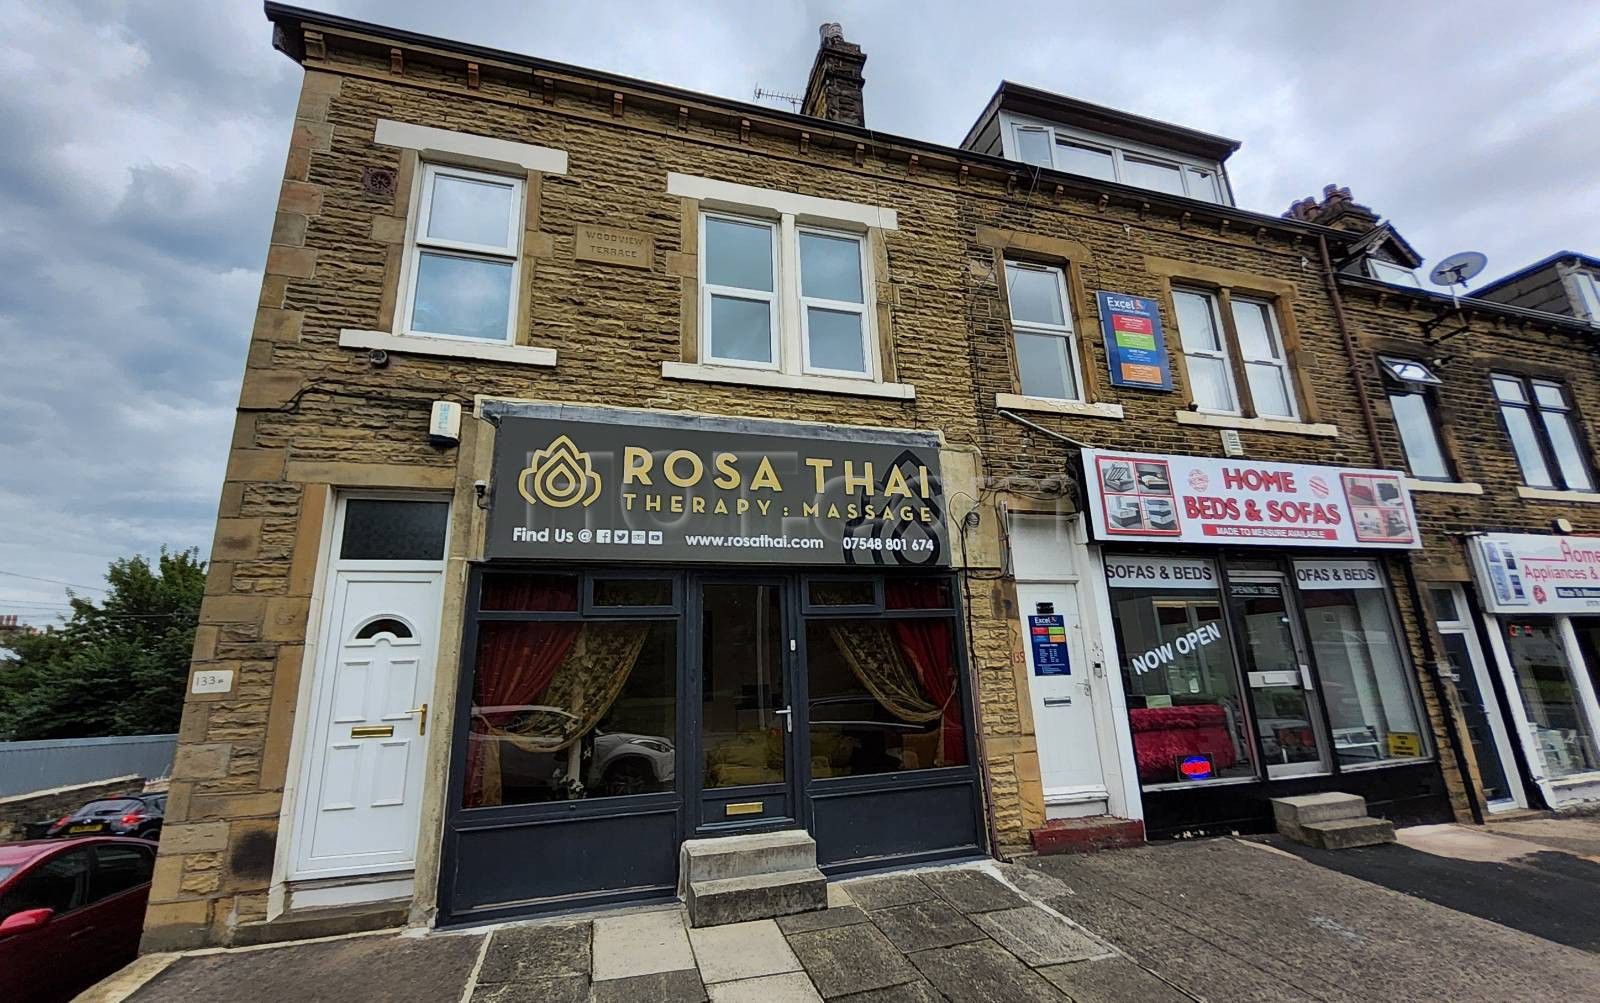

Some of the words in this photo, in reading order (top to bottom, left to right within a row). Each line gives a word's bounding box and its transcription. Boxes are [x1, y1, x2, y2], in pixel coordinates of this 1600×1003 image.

[590, 245, 637, 258] TERRACE
[1106, 296, 1135, 310] Excel
[623, 446, 783, 491] ROSA
[805, 458, 930, 499] THAI
[1222, 467, 1297, 493] HOME
[622, 493, 773, 516] THERAPY
[803, 502, 933, 522] MASSAGE
[1182, 496, 1241, 520] BEDS
[1245, 499, 1263, 521] &
[1266, 500, 1341, 525] SOFAS
[513, 526, 548, 543] Find
[554, 528, 575, 543] Us
[577, 528, 593, 544] @
[685, 532, 824, 550] www.rosathai.com
[1215, 527, 1239, 536] MADE
[1240, 528, 1250, 536] TO
[1249, 528, 1287, 537] MEASURE
[1287, 529, 1325, 539] AVAILABLE
[843, 535, 882, 551] 07548
[885, 536, 908, 551] 801
[911, 537, 934, 552] 674
[1105, 565, 1155, 580] SOFAS
[1159, 566, 1170, 580] &
[1173, 566, 1212, 580] BEDS
[1332, 569, 1342, 581] &
[1342, 568, 1376, 581] BEDS
[1524, 564, 1587, 582] Appliances
[1589, 567, 1598, 579] &
[1231, 586, 1259, 594] OPENING
[1260, 586, 1279, 595] TIMES
[1131, 642, 1174, 675] NOW
[1176, 622, 1222, 654] OPEN
